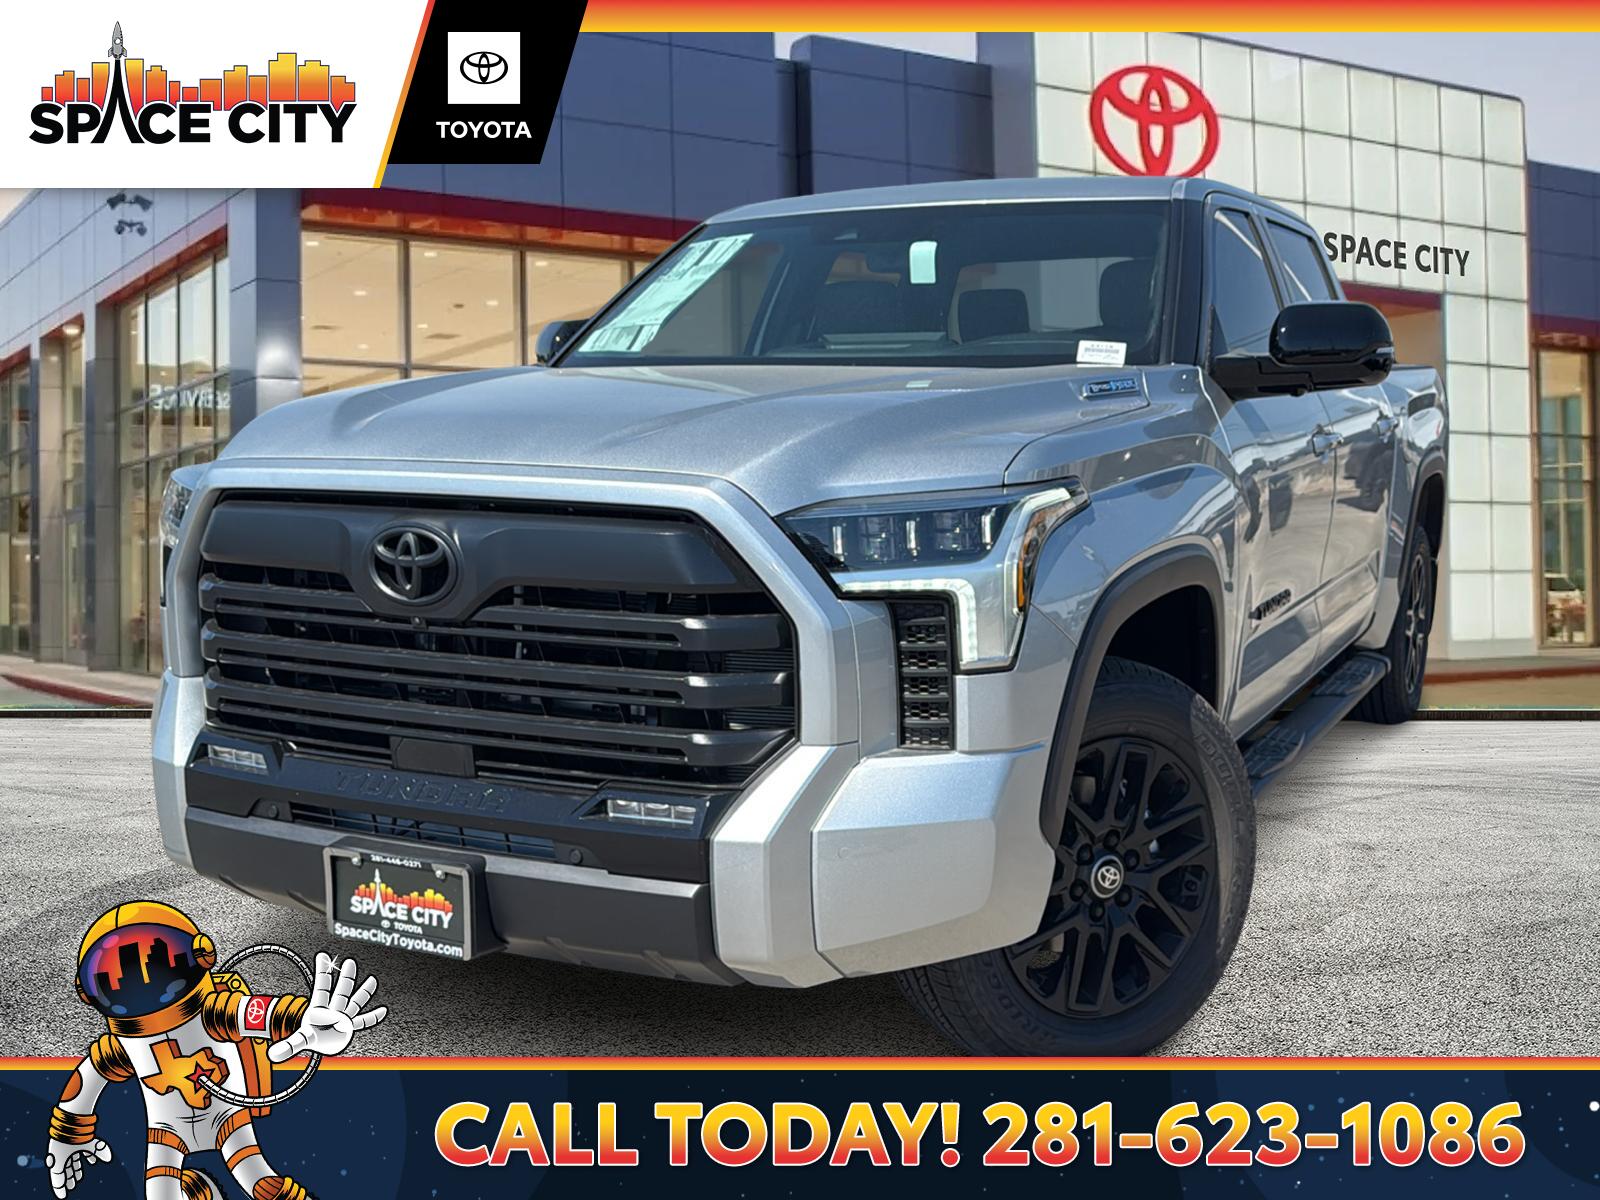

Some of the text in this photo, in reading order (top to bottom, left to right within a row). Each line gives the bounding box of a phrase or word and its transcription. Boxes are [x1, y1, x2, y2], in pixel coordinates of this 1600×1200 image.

[1323, 231, 1470, 277] SPACE CITY
[336, 770, 512, 813] TUNDRA
[350, 893, 453, 929] SPACE CITY
[394, 921, 423, 935] TOYOTA
[334, 922, 463, 958] SpaceCityToyota.com
